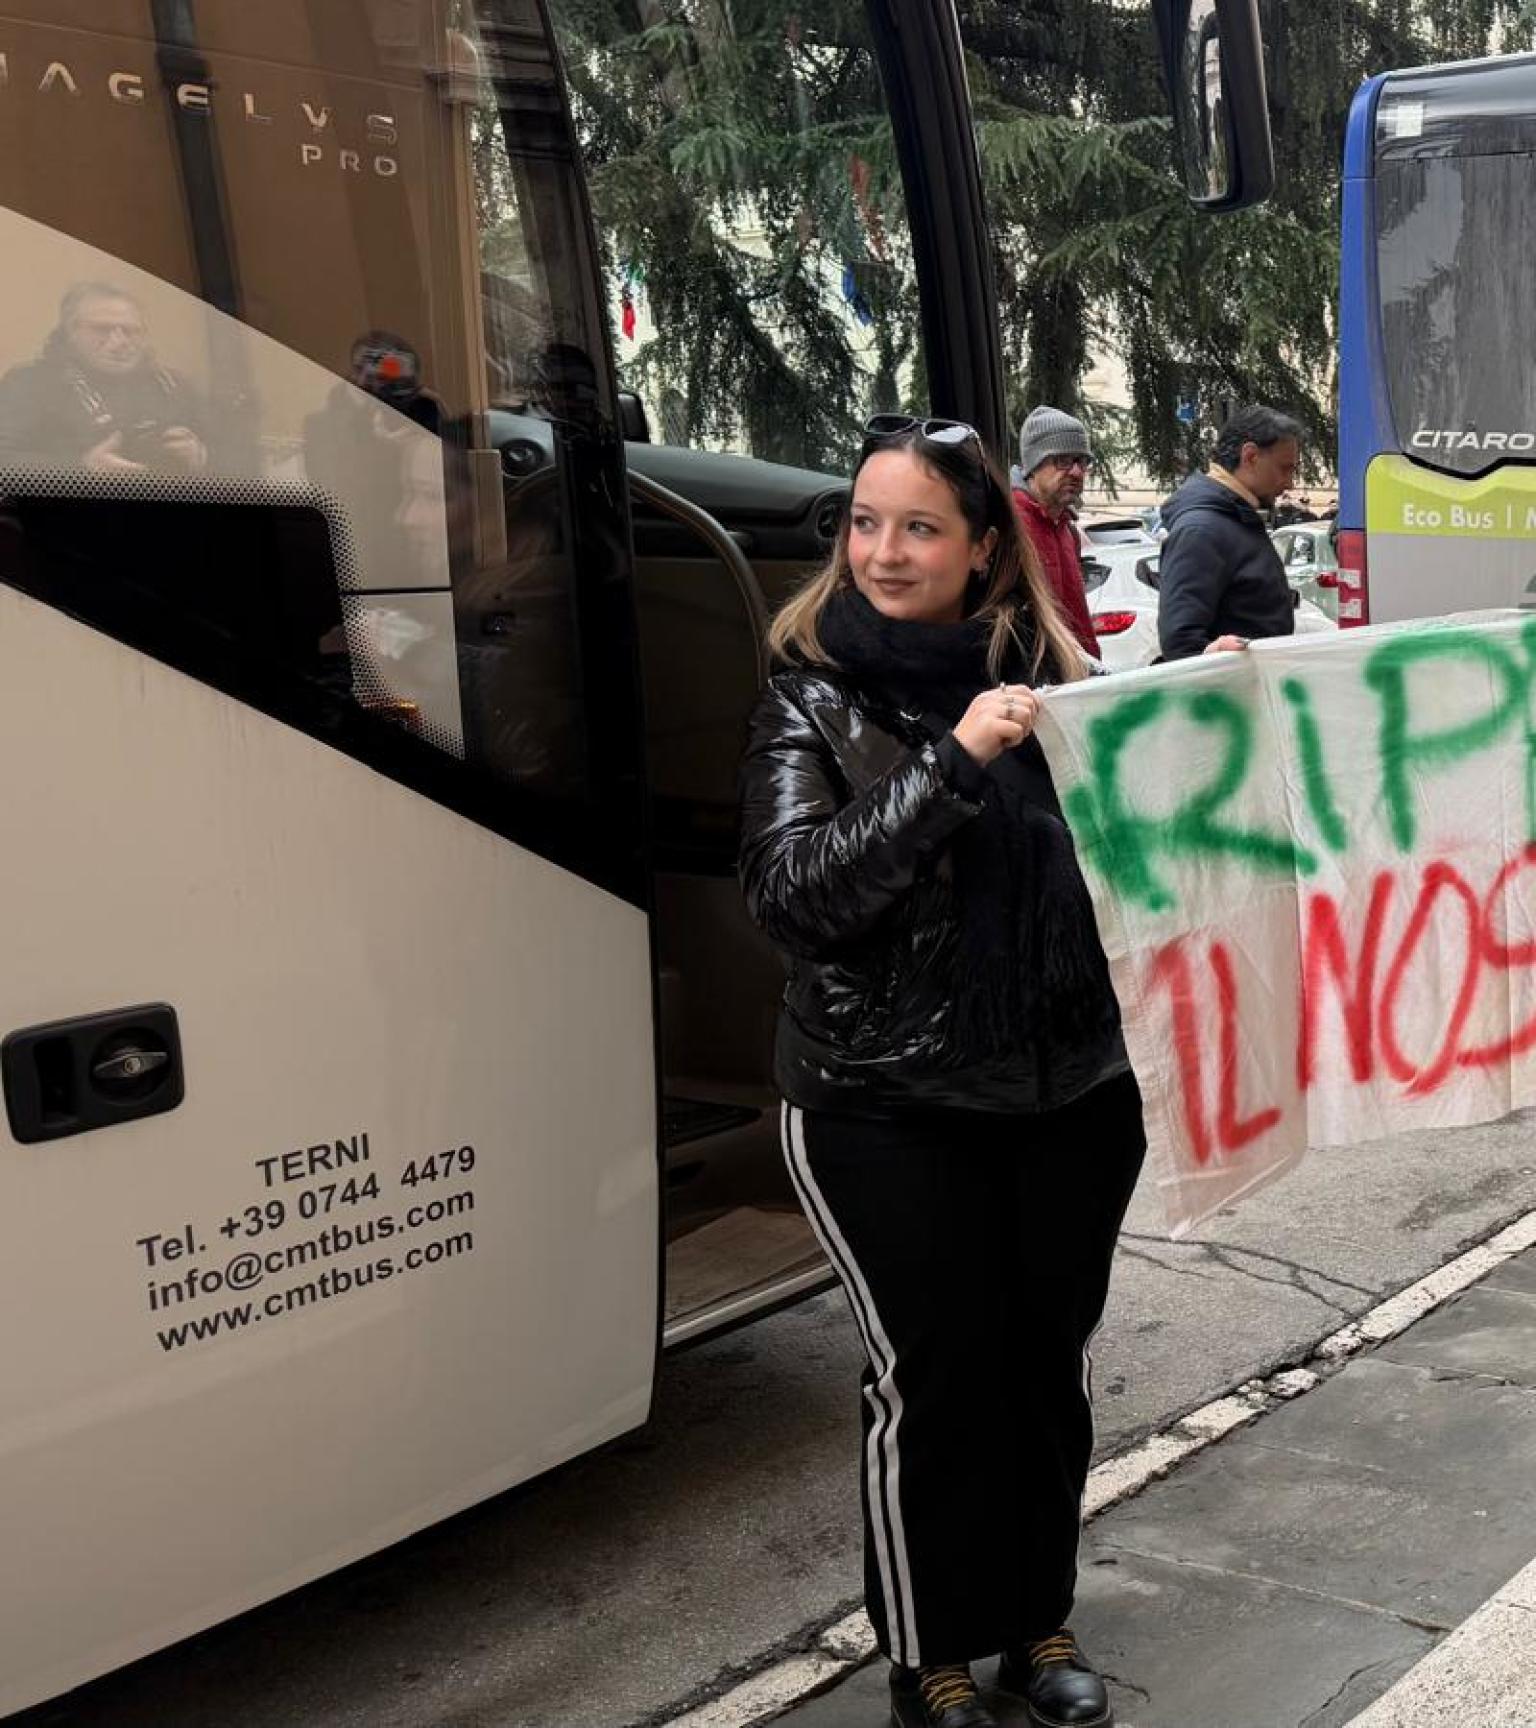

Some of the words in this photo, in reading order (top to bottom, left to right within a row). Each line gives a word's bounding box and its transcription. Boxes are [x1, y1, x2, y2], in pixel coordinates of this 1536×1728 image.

[302, 144, 397, 176] PRO
[1412, 430, 1535, 450] CITARO
[1402, 503, 1441, 528] Eco
[1450, 504, 1494, 529] Bus
[1148, 936, 1281, 1164] IL
[255, 1132, 370, 1187] TERNI
[136, 1225, 207, 1266] Tel.
[219, 1200, 285, 1239] +39
[298, 1172, 380, 1219] 0744
[400, 1145, 475, 1188] 4479
[147, 1191, 475, 1311] info@cmtbus.com
[156, 1231, 473, 1351] www.cmtbus.com
